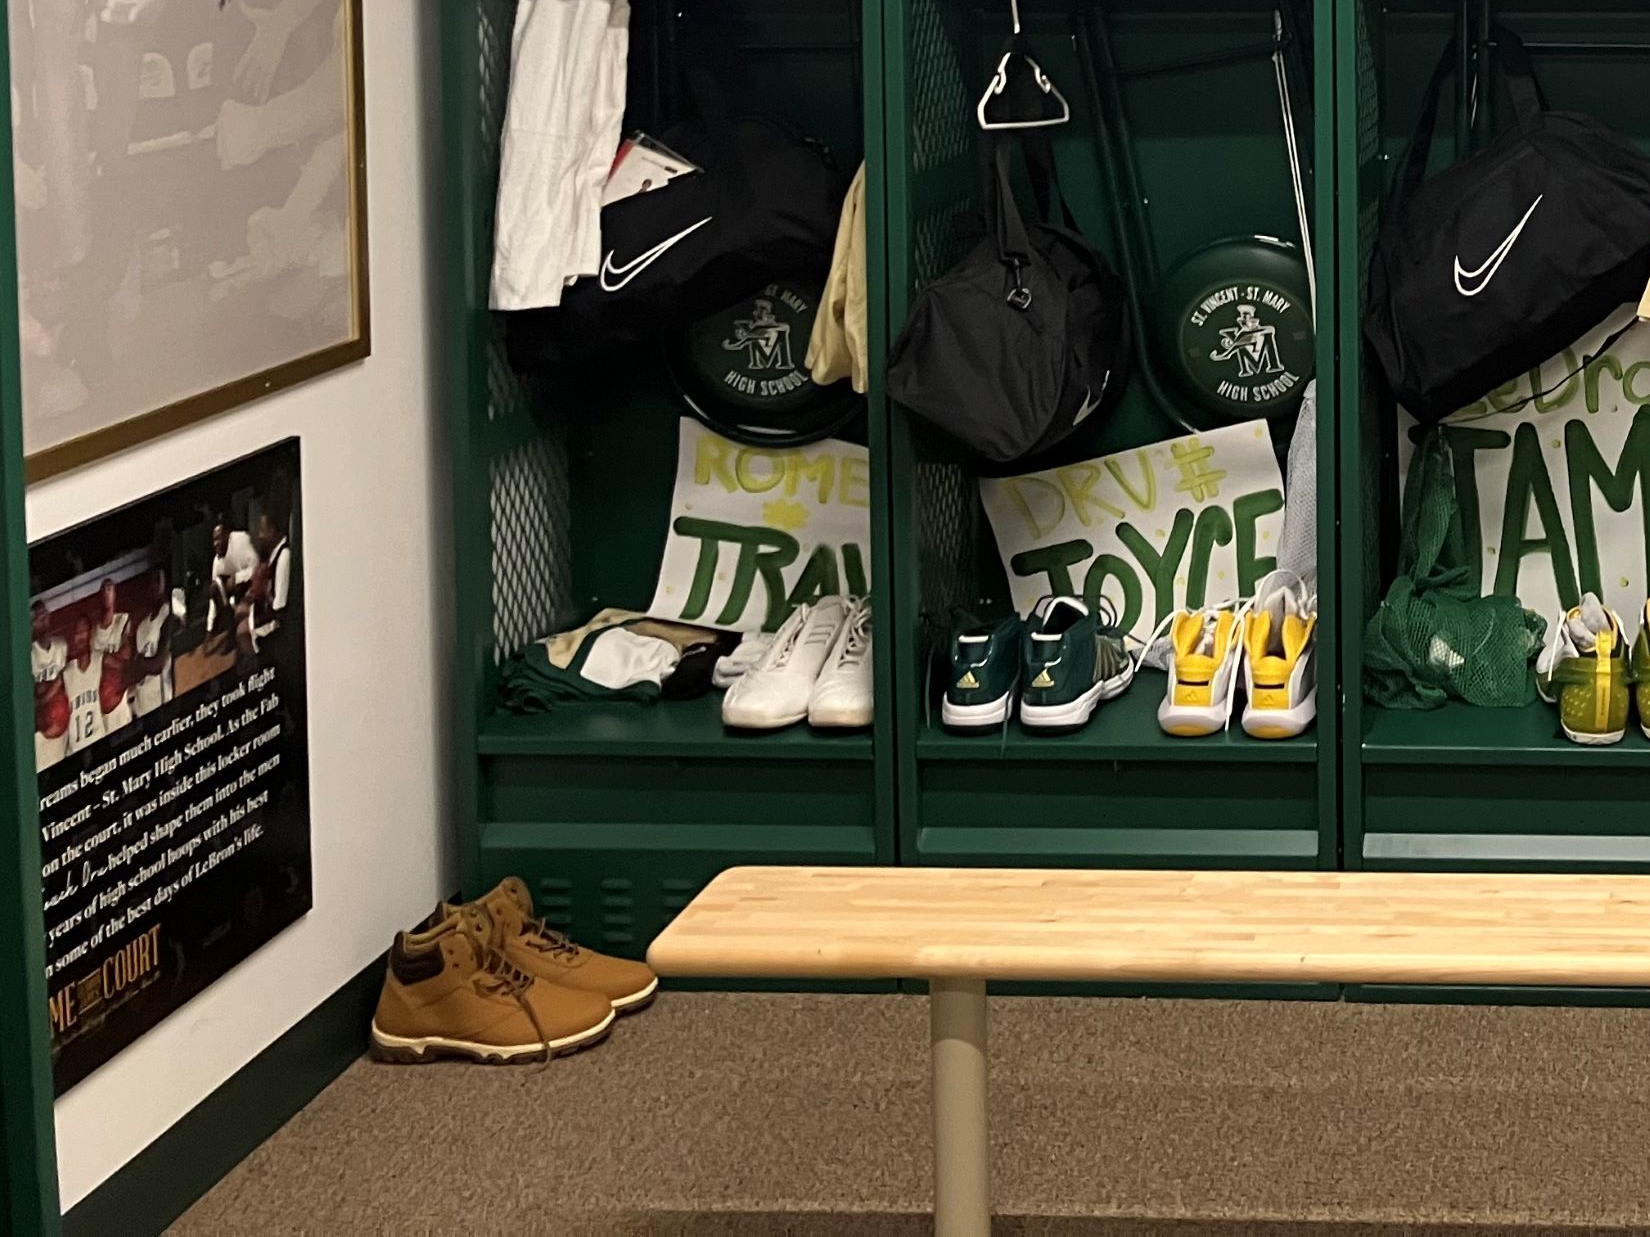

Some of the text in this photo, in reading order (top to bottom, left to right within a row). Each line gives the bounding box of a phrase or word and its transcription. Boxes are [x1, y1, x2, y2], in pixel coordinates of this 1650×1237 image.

[1200, 286, 1239, 314] VINCENT
[1246, 286, 1261, 302] ST.
[1261, 289, 1292, 314] MARY
[723, 369, 809, 396] HIGH SCHOOL
[1216, 370, 1300, 402] HIGH SCHOOL
[41, 804, 92, 842] Vincent
[102, 789, 120, 809] St.
[121, 769, 153, 795] Mary
[154, 749, 183, 778] High
[183, 724, 225, 761] School.
[226, 718, 241, 737] As
[241, 706, 259, 727] the
[260, 692, 280, 716] Fab
[74, 710, 94, 743] 12
[79, 757, 118, 788] began
[118, 734, 152, 766] much
[153, 714, 195, 746] earlier,
[195, 699, 220, 722] they
[221, 681, 246, 708] took
[247, 666, 276, 693] flight
[42, 723, 281, 878] on the court, it was inside this locker room
[107, 831, 149, 871] helped
[150, 814, 184, 845] shape
[185, 795, 214, 822] them
[215, 782, 238, 803] into
[239, 769, 257, 789] the
[257, 754, 281, 777] men
[48, 789, 269, 948] years of high school hoops with his best
[55, 940, 89, 972] some
[90, 923, 105, 949] of
[105, 915, 126, 938] the
[127, 897, 152, 924] best
[153, 878, 181, 906] days
[181, 864, 195, 887] of
[195, 835, 243, 879] LeBron's
[243, 823, 265, 846] life.
[102, 922, 163, 1000] COURT
